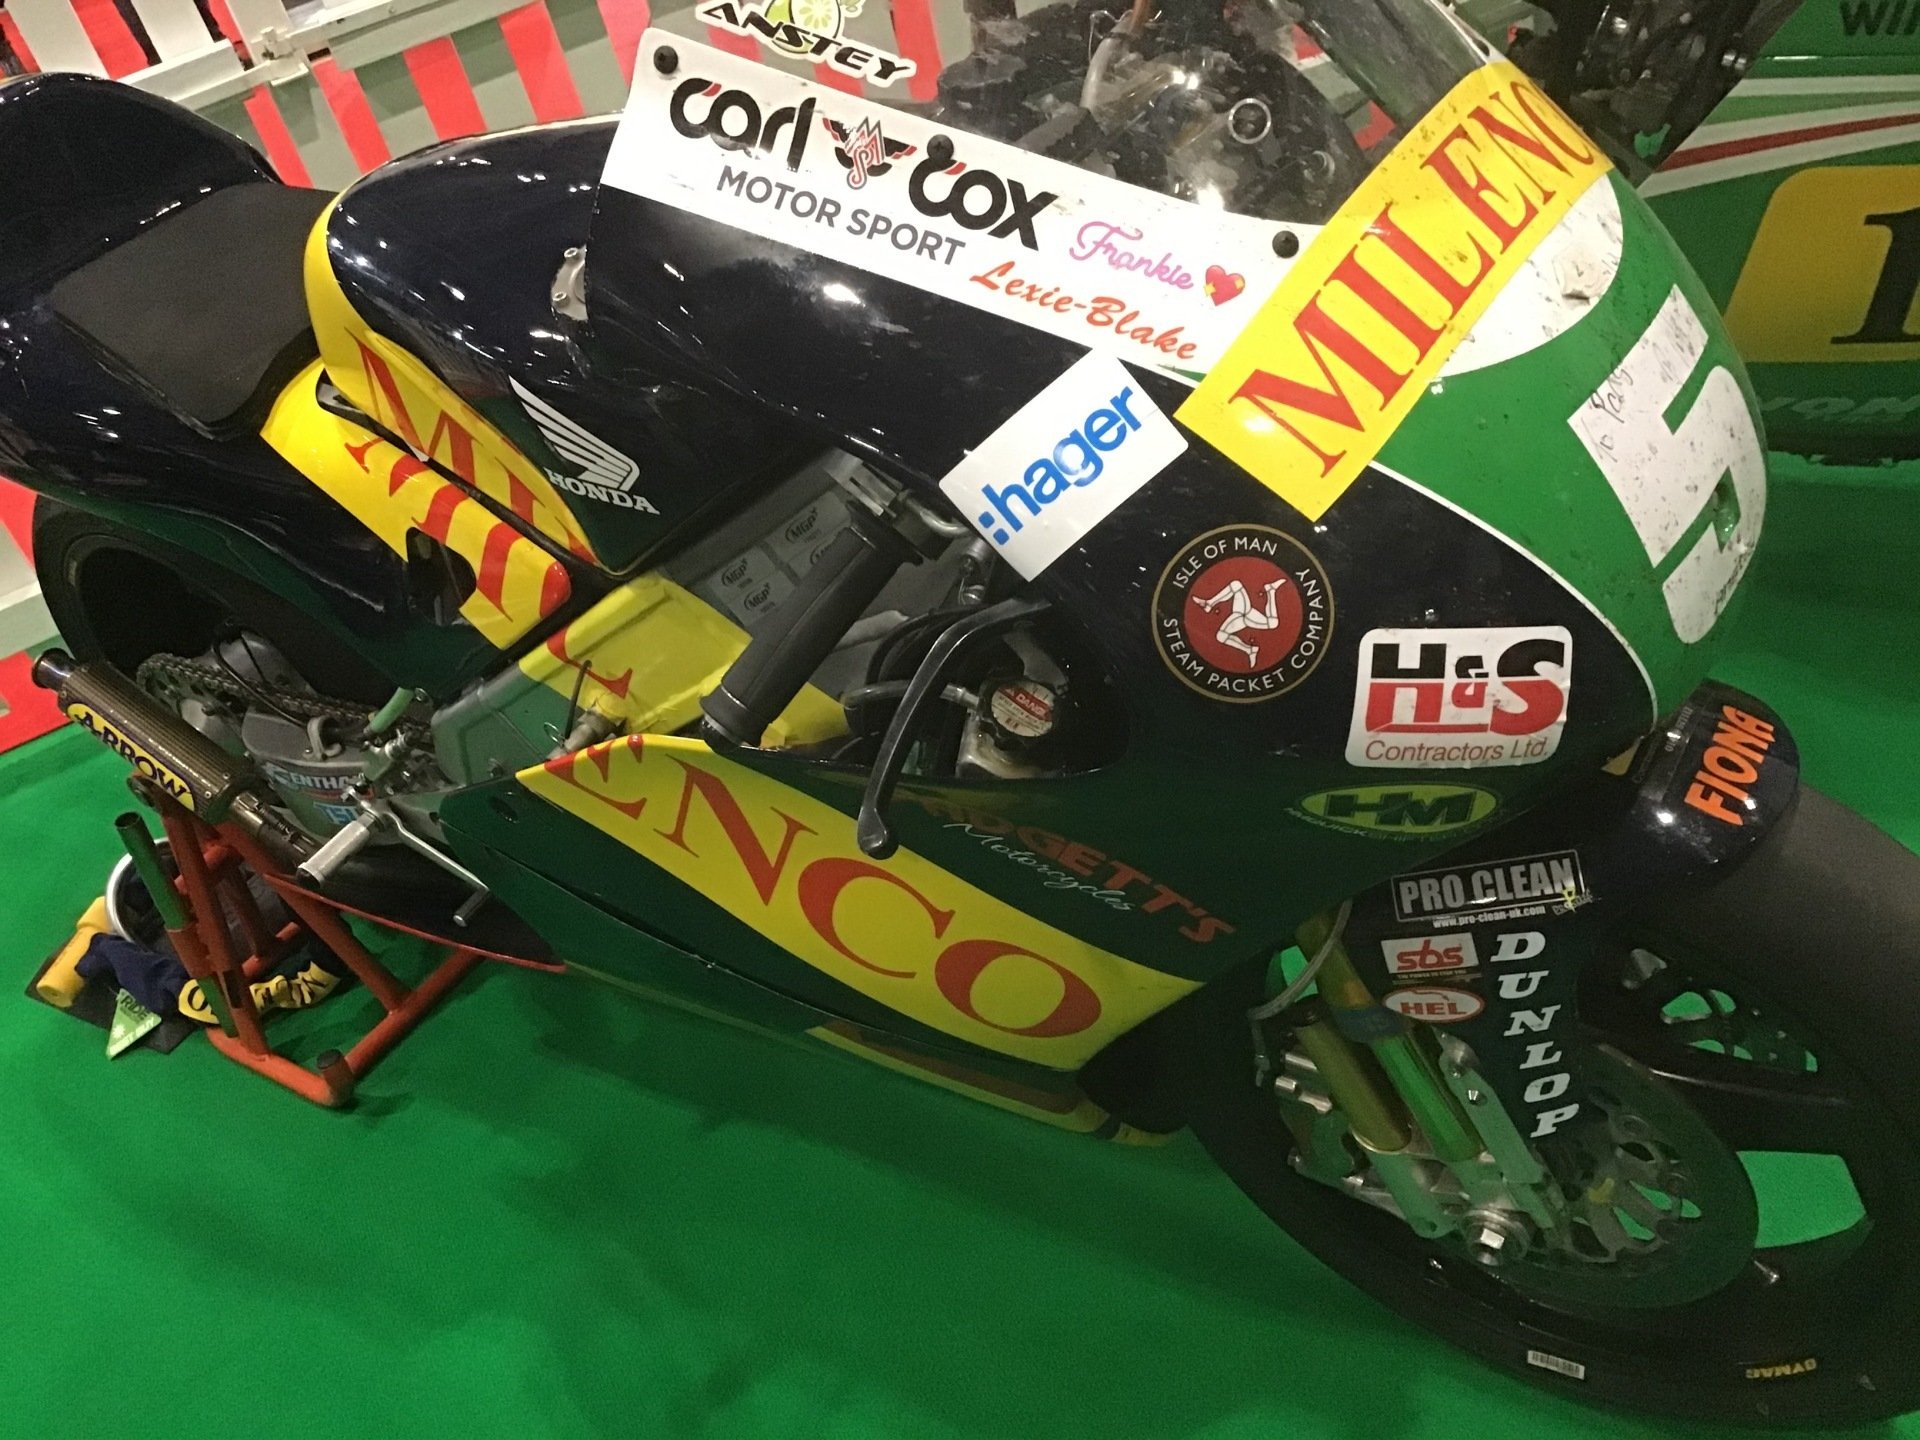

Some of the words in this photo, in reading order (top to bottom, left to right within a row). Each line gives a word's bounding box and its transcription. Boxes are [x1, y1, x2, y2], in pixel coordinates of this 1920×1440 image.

[703, 2, 910, 80] ANSTEY
[716, 165, 841, 228] MOTOR
[846, 208, 966, 265] SPORT
[1069, 221, 1194, 290] Frankie
[969, 261, 1197, 360] Lexie-Blake
[543, 466, 660, 515] HONDA
[1173, 555, 1202, 588] ISLE
[1204, 539, 1228, 559] OF
[1235, 537, 1278, 556] MAN
[1164, 618, 1204, 677] STEAM
[1207, 668, 1287, 693] PACKET
[1291, 568, 1324, 669] COMPANY
[1365, 638, 1565, 736] H&S
[74, 711, 191, 798] ARROW
[1365, 739, 1504, 762] Contractors
[1510, 736, 1549, 759] Ltd.
[1684, 705, 1776, 826] FIONA
[1324, 791, 1477, 826] HM
[1400, 874, 1465, 914] PRO
[1471, 858, 1576, 905] CLEAN
[1397, 939, 1464, 971] sbs
[1400, 1001, 1466, 1015] HEL
